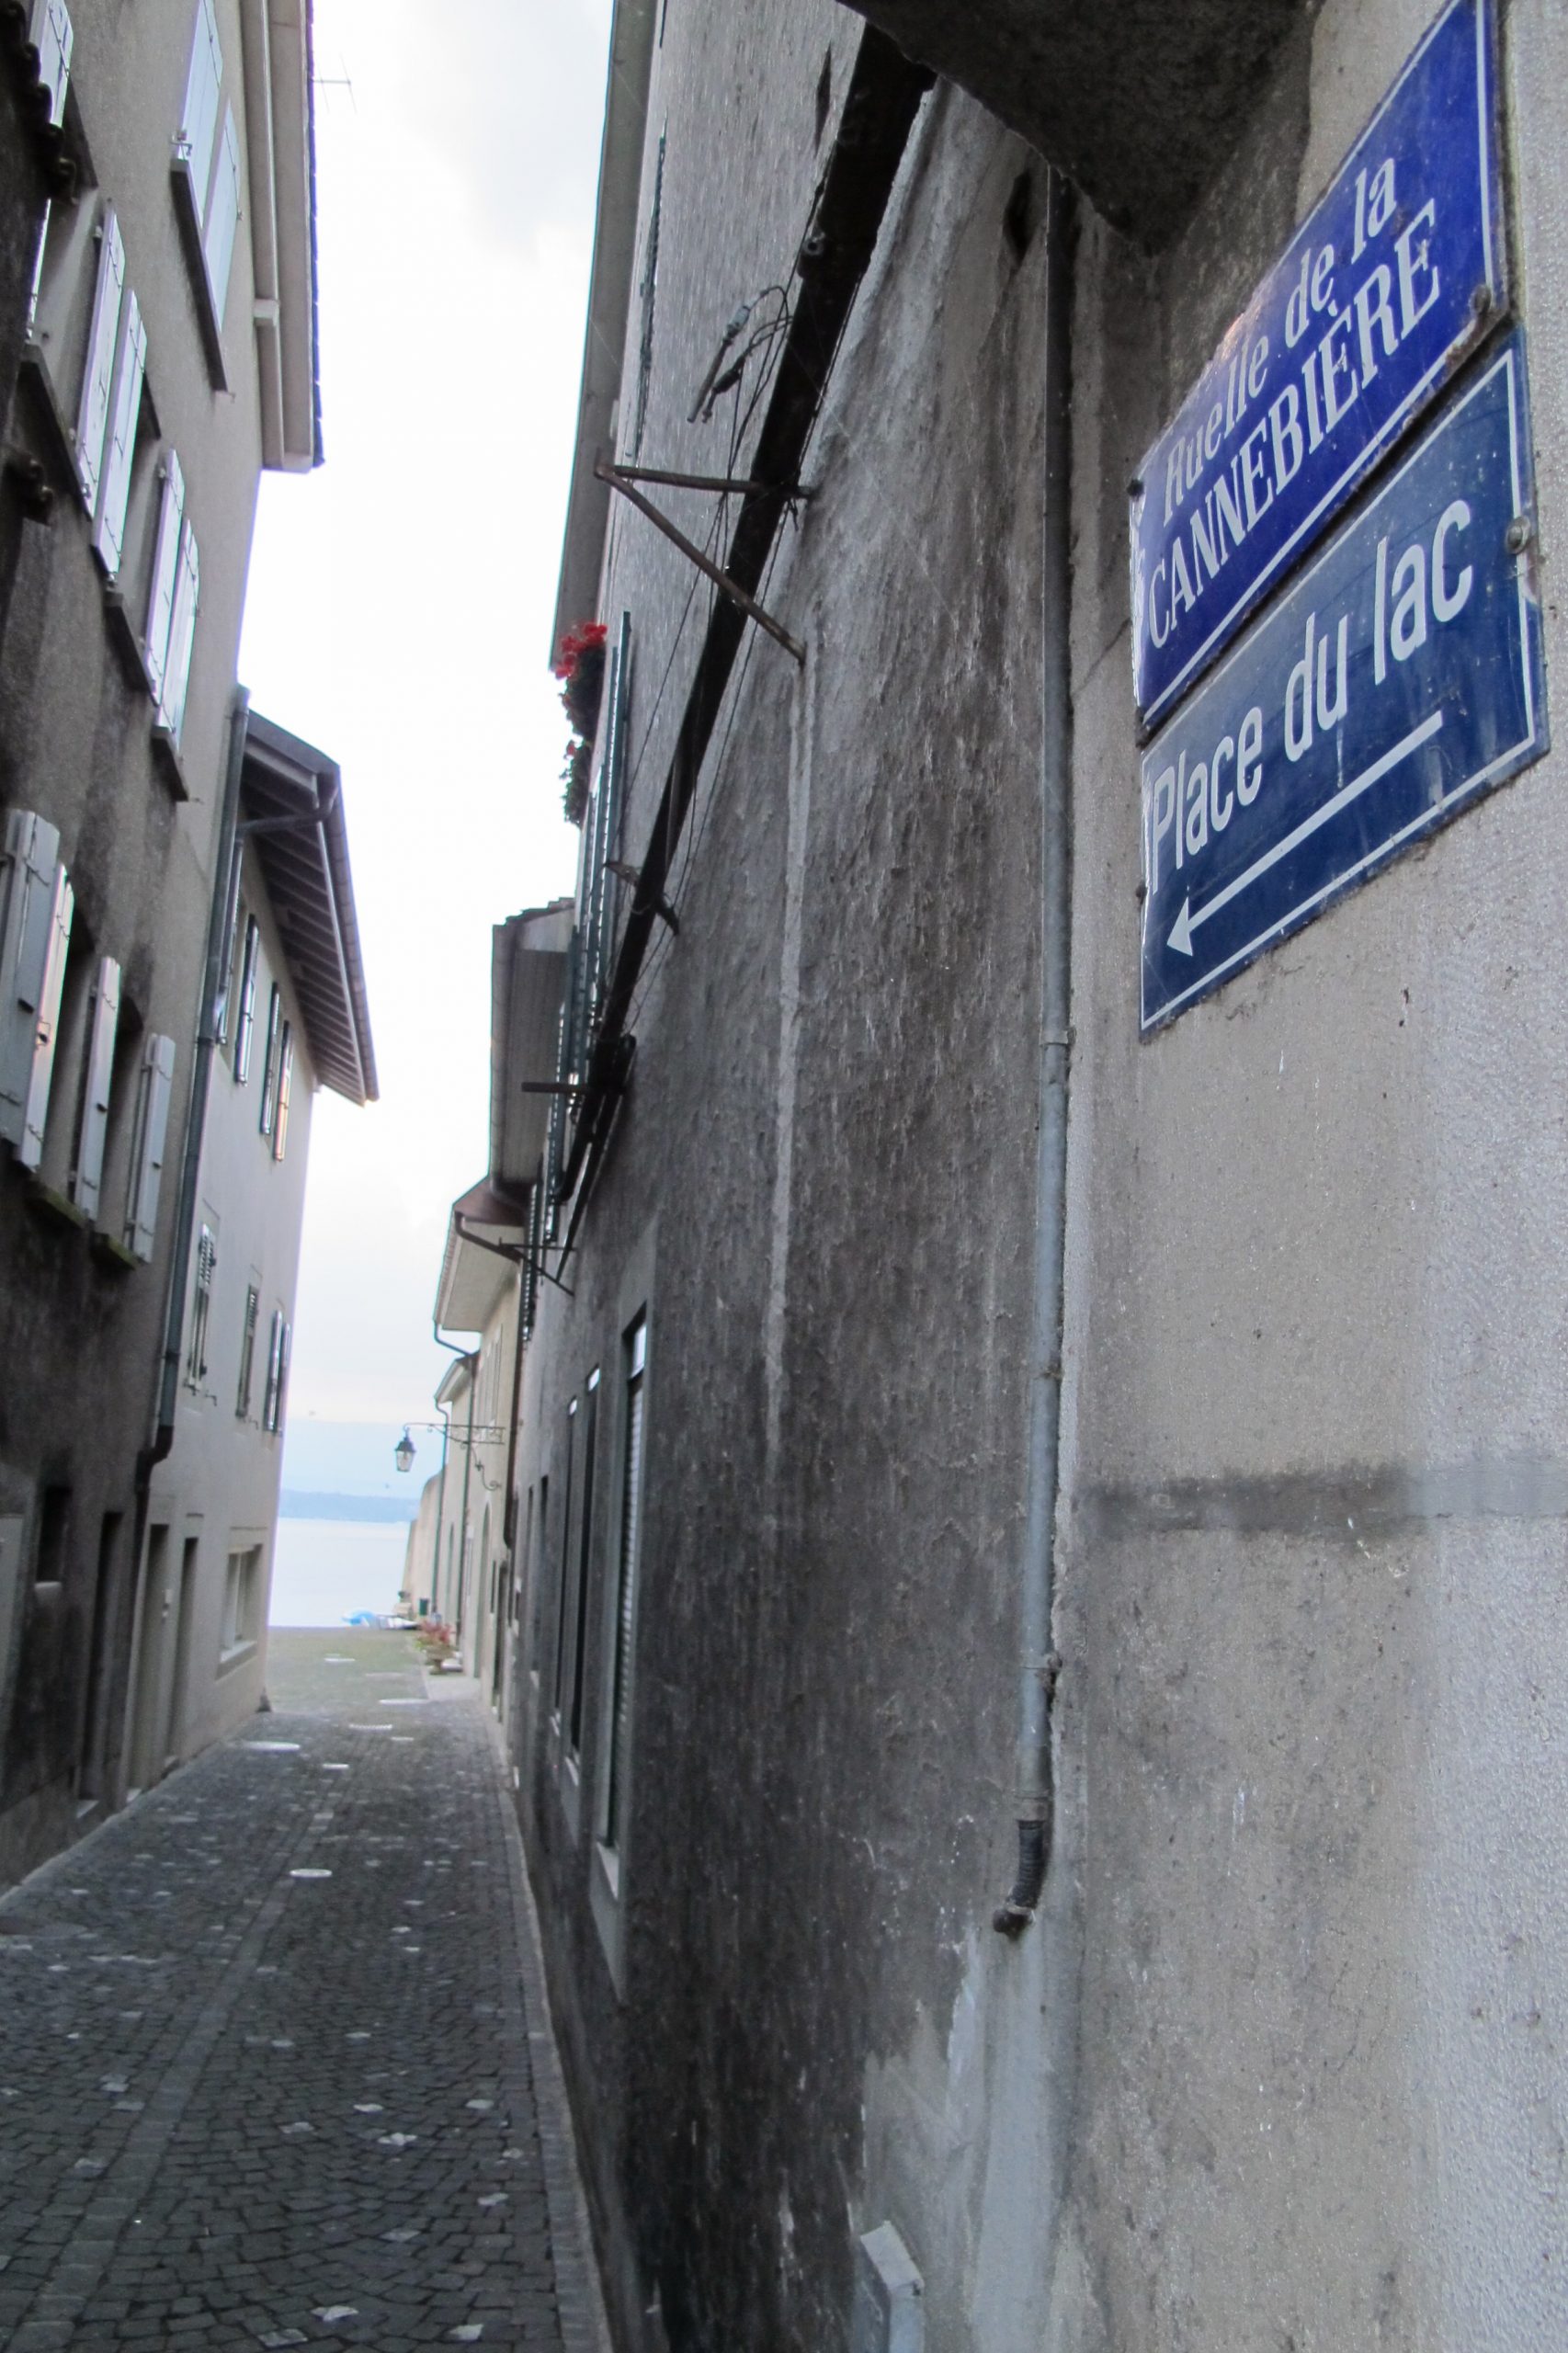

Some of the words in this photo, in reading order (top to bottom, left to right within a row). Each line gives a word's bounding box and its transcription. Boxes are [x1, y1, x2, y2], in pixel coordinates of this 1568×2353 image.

[1148, 199, 1439, 649] CANNEBIÈRE
[1164, 335, 1268, 528] Ruelle
[1284, 243, 1335, 348] de
[1350, 157, 1396, 265] la
[1152, 706, 1263, 894] Place
[1284, 611, 1347, 762] du
[1374, 499, 1472, 686] lac
